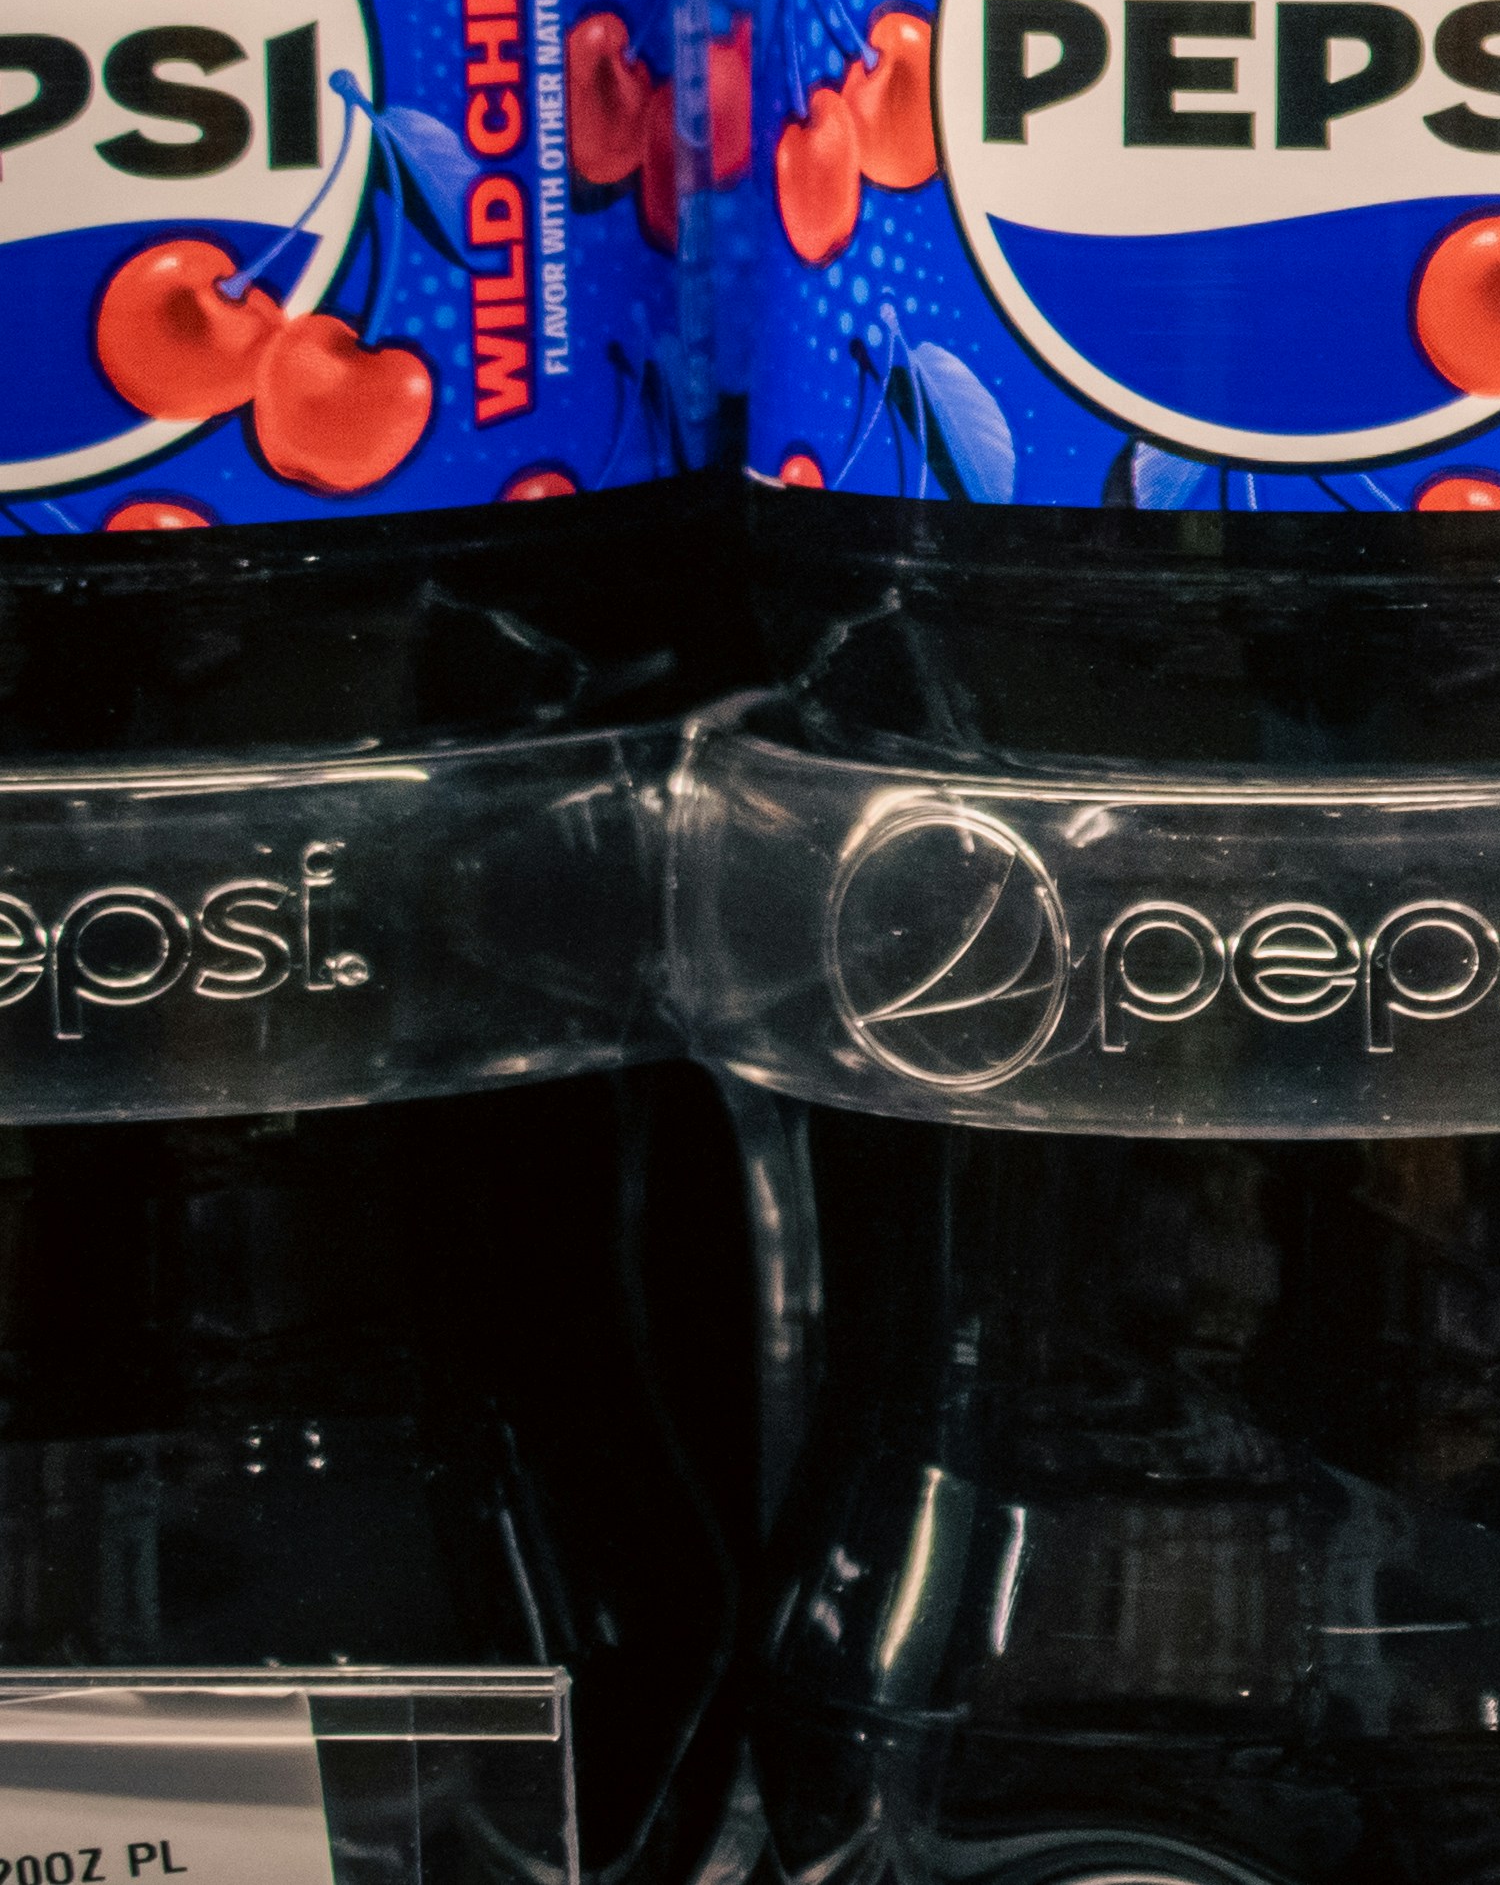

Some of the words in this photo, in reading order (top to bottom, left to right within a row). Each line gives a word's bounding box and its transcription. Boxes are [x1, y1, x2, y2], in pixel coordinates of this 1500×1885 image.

[537, 73, 565, 172] OTHER
[540, 176, 568, 255] WITH
[469, 176, 529, 420] WILD
[541, 263, 570, 374] FLAVOR
[127, 1839, 188, 1878] PL
